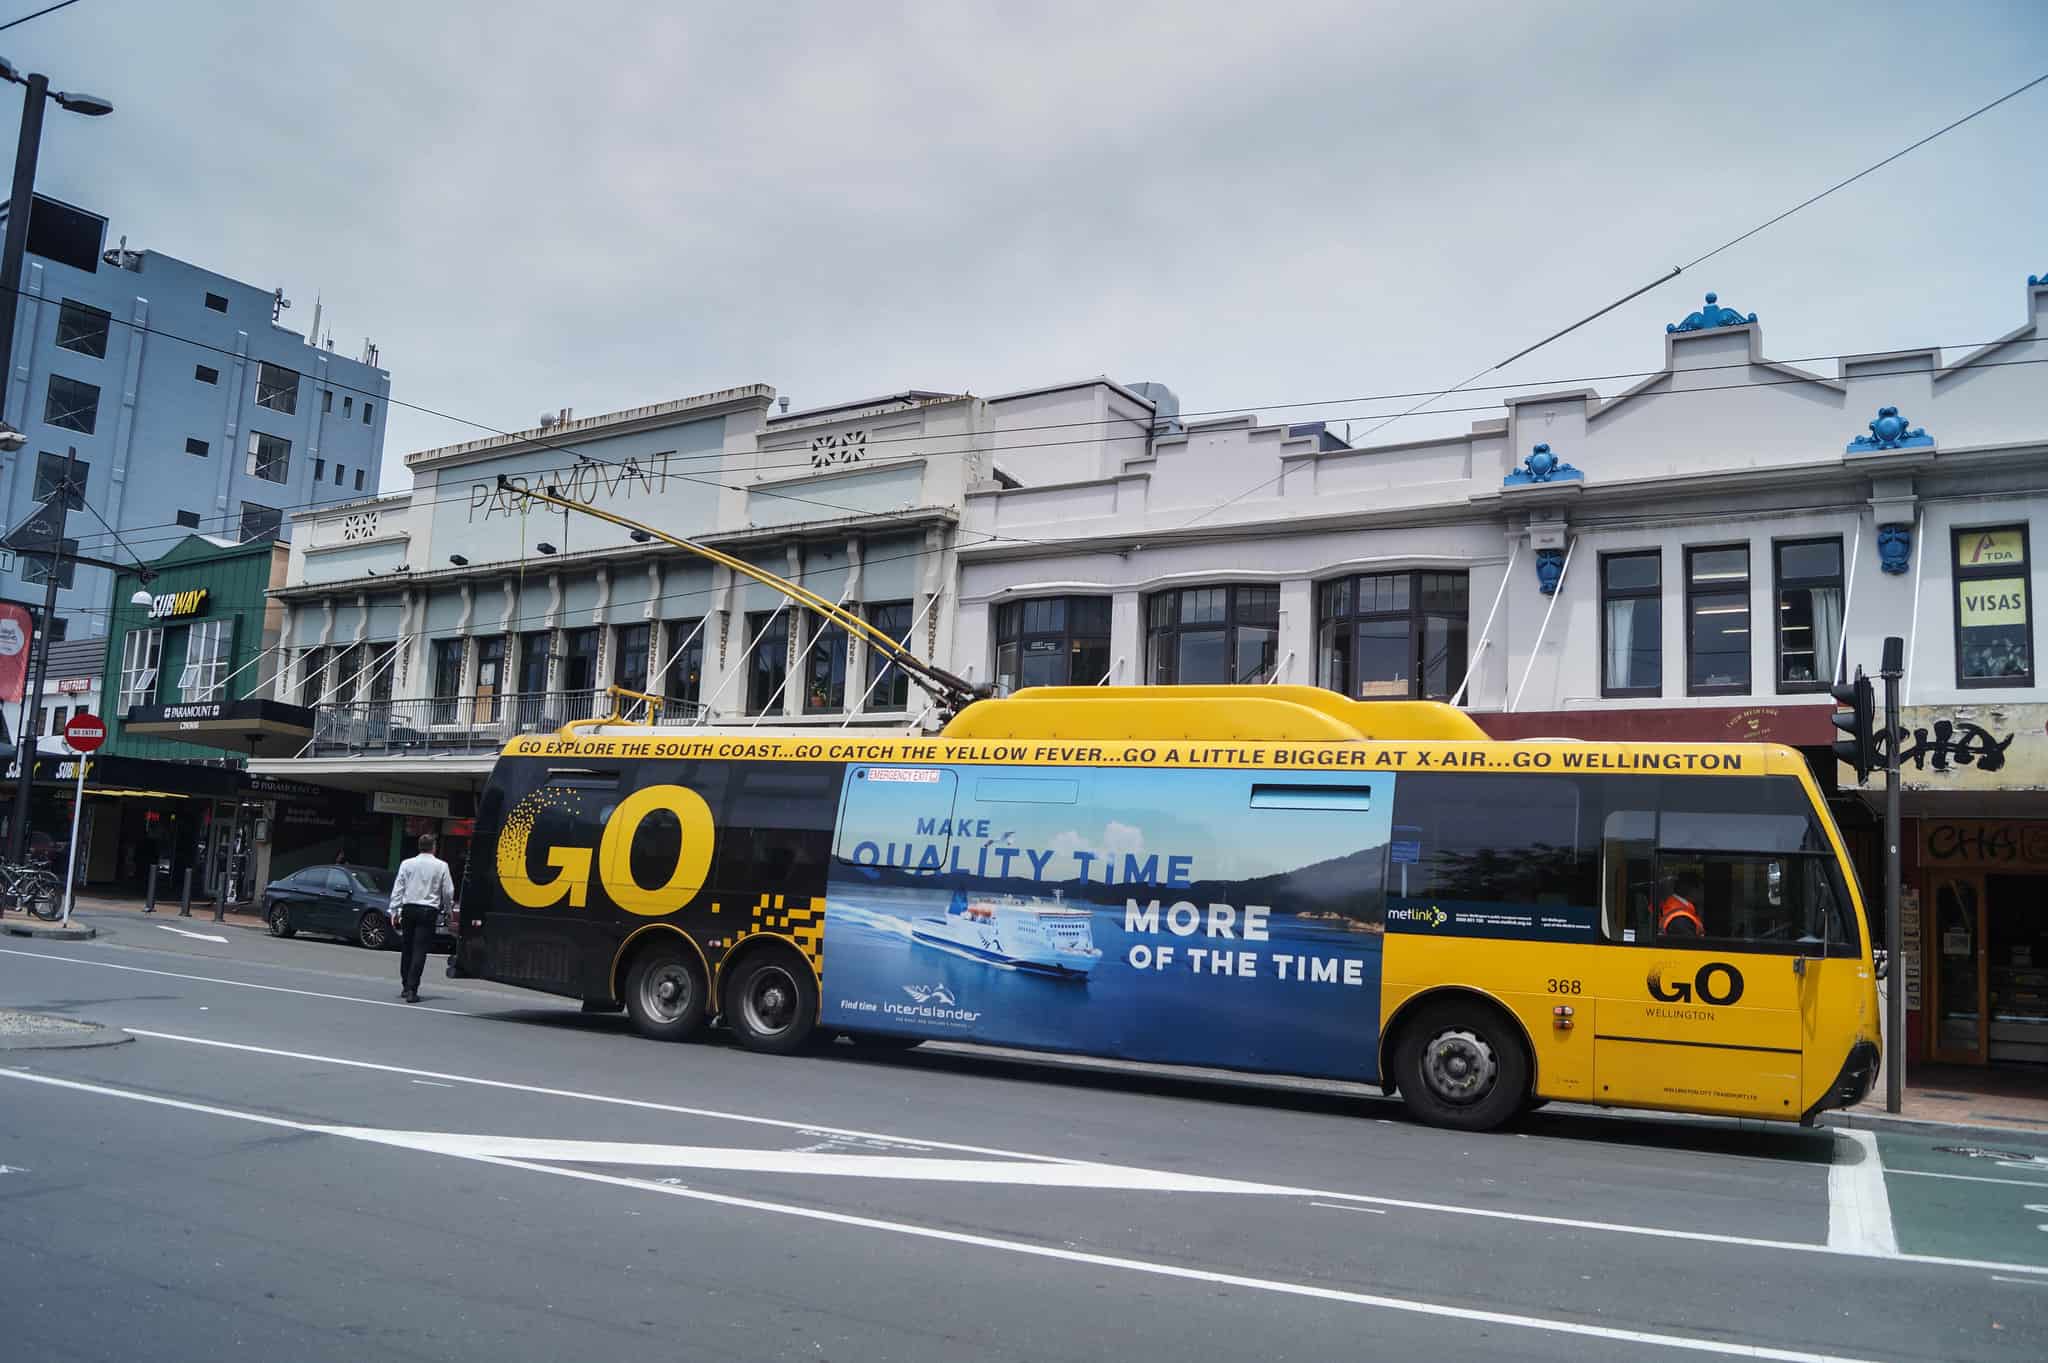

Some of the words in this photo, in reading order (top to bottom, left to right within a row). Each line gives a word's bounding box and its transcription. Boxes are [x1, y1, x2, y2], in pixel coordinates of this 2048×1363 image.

[1984, 551, 2013, 561] TDA
[148, 589, 206, 618] SUBWAY
[1965, 593, 2022, 612] VISAS
[518, 741, 541, 754] GO
[545, 742, 615, 756] EXPLORE
[620, 743, 650, 757] THE
[654, 743, 713, 758] SOUTH
[829, 745, 893, 760] CATCH
[901, 746, 937, 760] THE
[945, 746, 1028, 761] YELLOW
[1164, 748, 1180, 763] A
[1189, 748, 1265, 764] LITTLE
[1273, 749, 1367, 766] BIGGER
[1375, 751, 1408, 766] AT
[1562, 753, 1743, 770] WELLINGTON
[916, 817, 991, 838] MAKE
[496, 784, 715, 917] GO
[852, 841, 1055, 881] QUALITY
[1124, 899, 1272, 941] MORE
[1388, 909, 1433, 921] metlink
[1129, 944, 1174, 971] OF
[1187, 947, 1258, 978] THE
[1272, 953, 1364, 986] TIME
[1547, 979, 1581, 995] 368
[1647, 962, 1744, 1006] GO
[840, 1000, 858, 1009] Find
[1645, 1008, 1715, 1021] WELLINGTON
